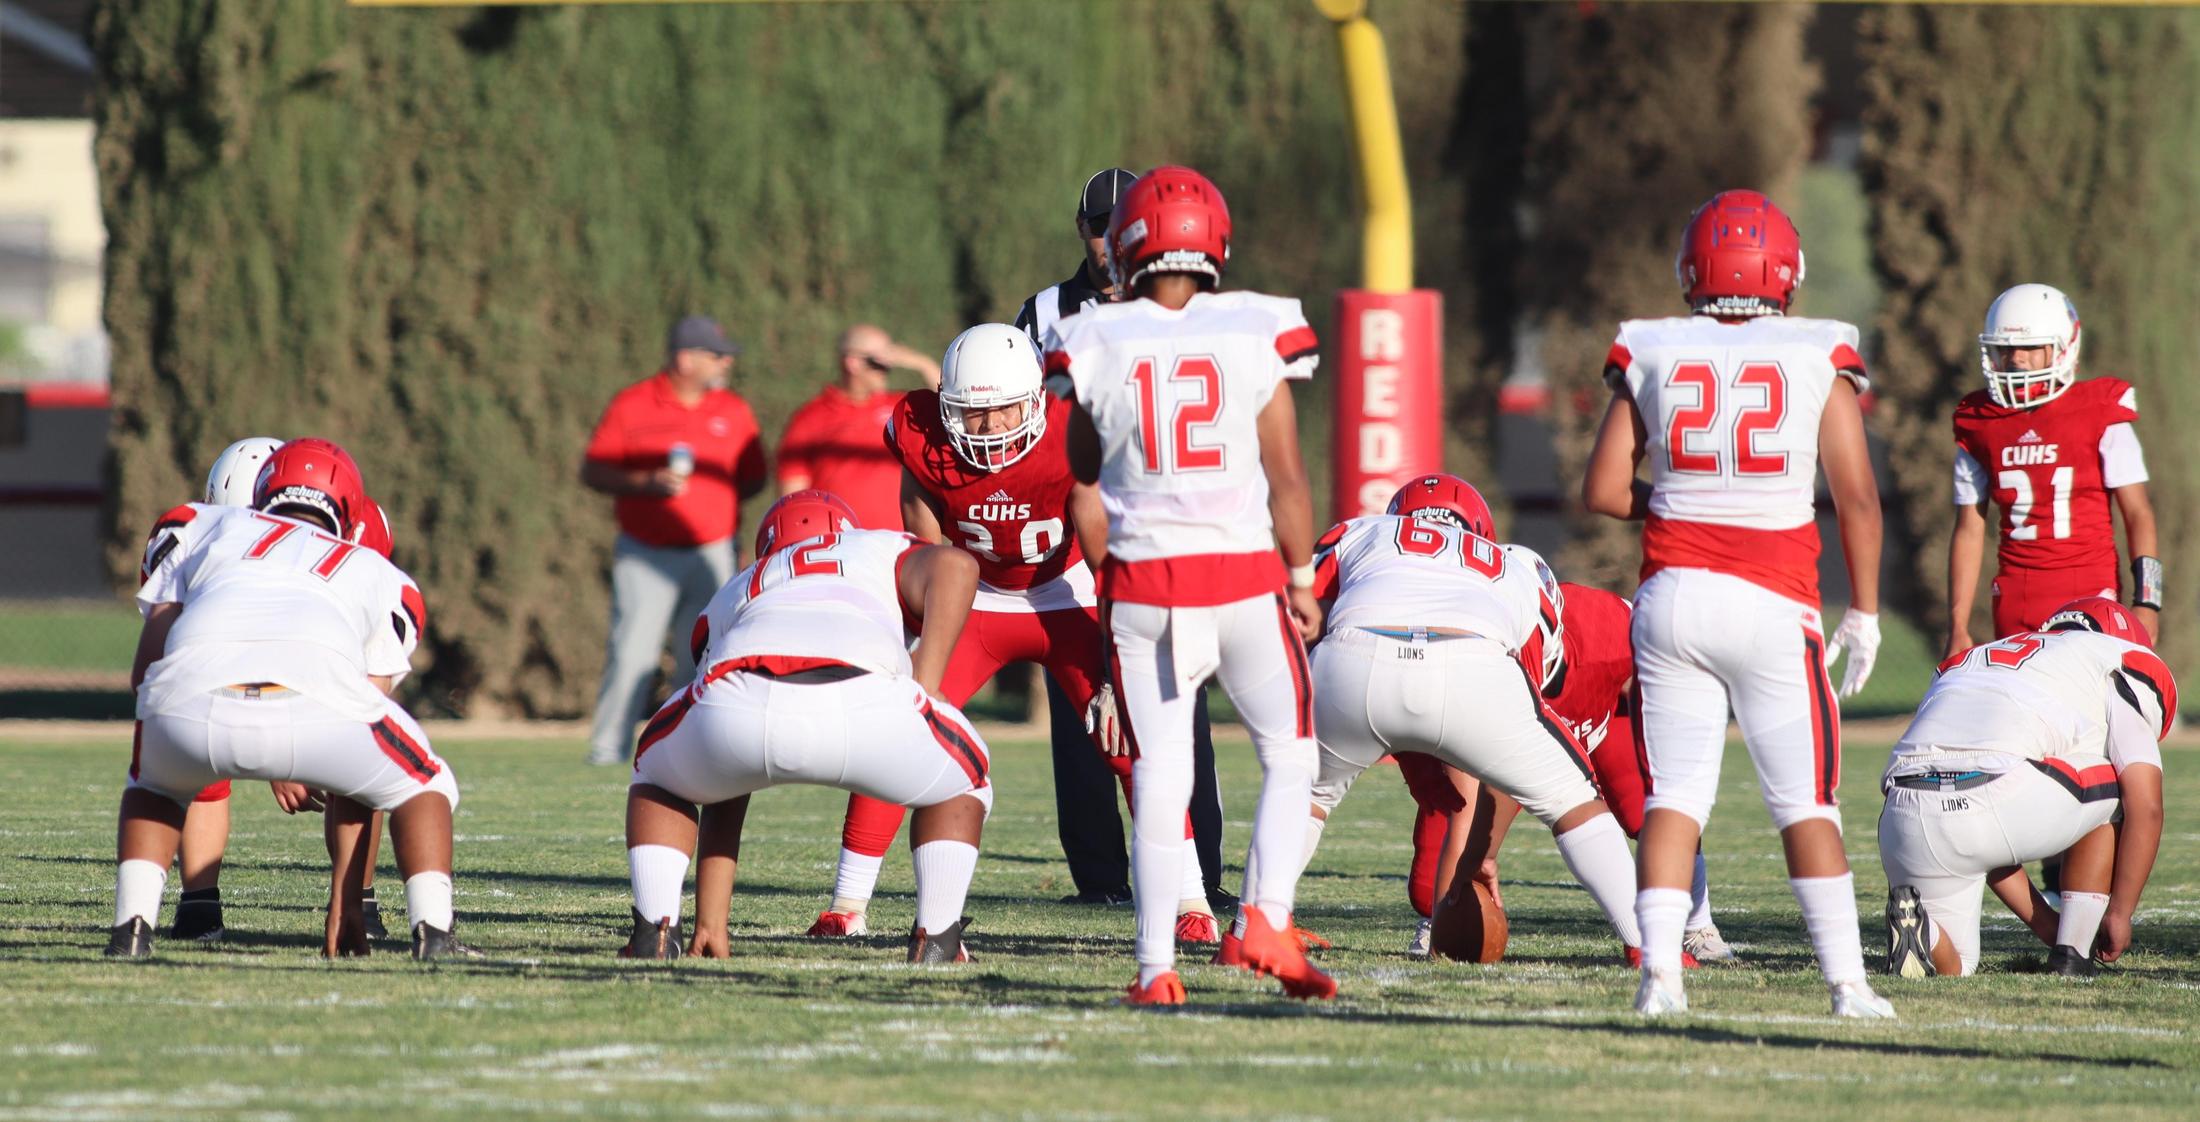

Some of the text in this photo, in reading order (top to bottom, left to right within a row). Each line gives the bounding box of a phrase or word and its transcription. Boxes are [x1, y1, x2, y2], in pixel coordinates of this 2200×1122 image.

[1716, 294, 1760, 308] schutt
[1126, 353, 1226, 475] 12
[1665, 359, 1789, 477] 22
[2001, 443, 2058, 466] CUHS
[284, 484, 326, 500] schutt
[1998, 466, 2074, 540] 21
[968, 503, 1031, 521] CUHS
[1411, 506, 1450, 518] schutt
[241, 512, 361, 583] 77
[957, 516, 1065, 564] 30
[1394, 516, 1506, 583] 60
[1397, 646, 1425, 660] LIONS
[1941, 798, 1969, 812] LIONS
